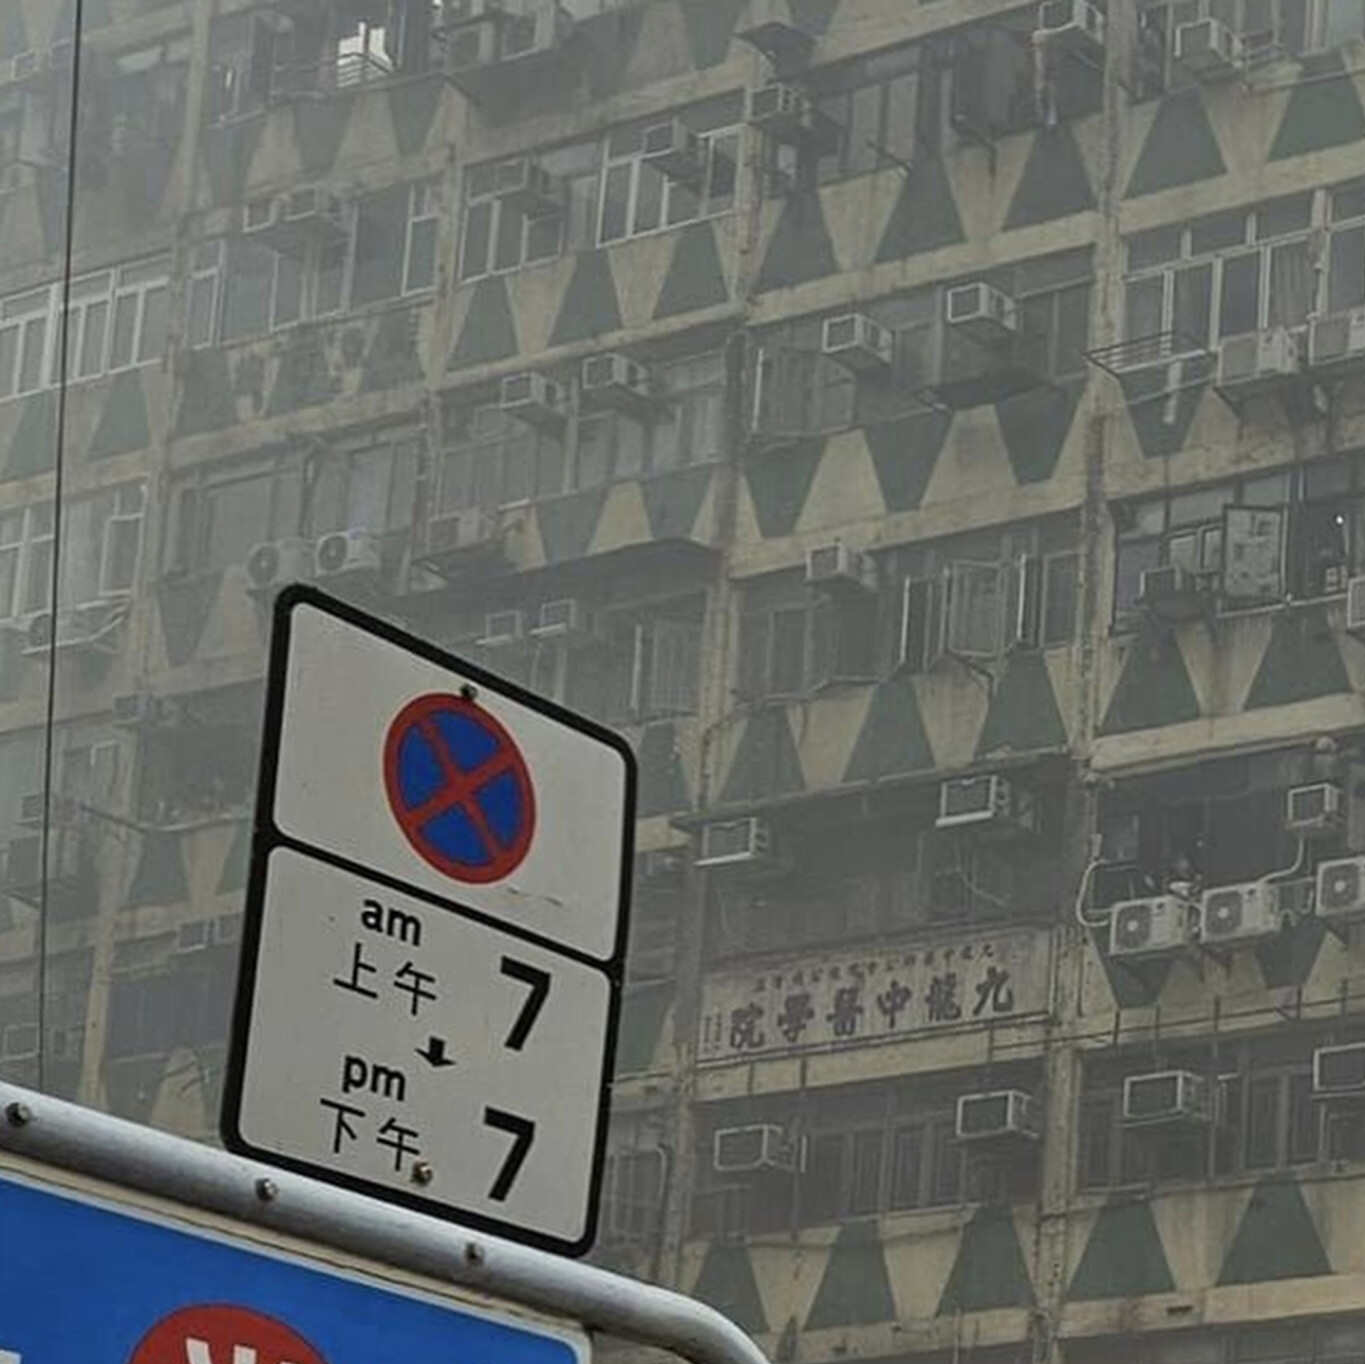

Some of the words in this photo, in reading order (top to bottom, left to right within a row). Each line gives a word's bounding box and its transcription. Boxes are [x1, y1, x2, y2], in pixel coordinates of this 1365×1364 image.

[362, 899, 423, 946] am
[333, 942, 437, 1017] 上午
[498, 956, 552, 1050] 7
[342, 1052, 406, 1104] pm
[320, 1098, 421, 1173] 下午
[482, 1107, 536, 1201] 7
